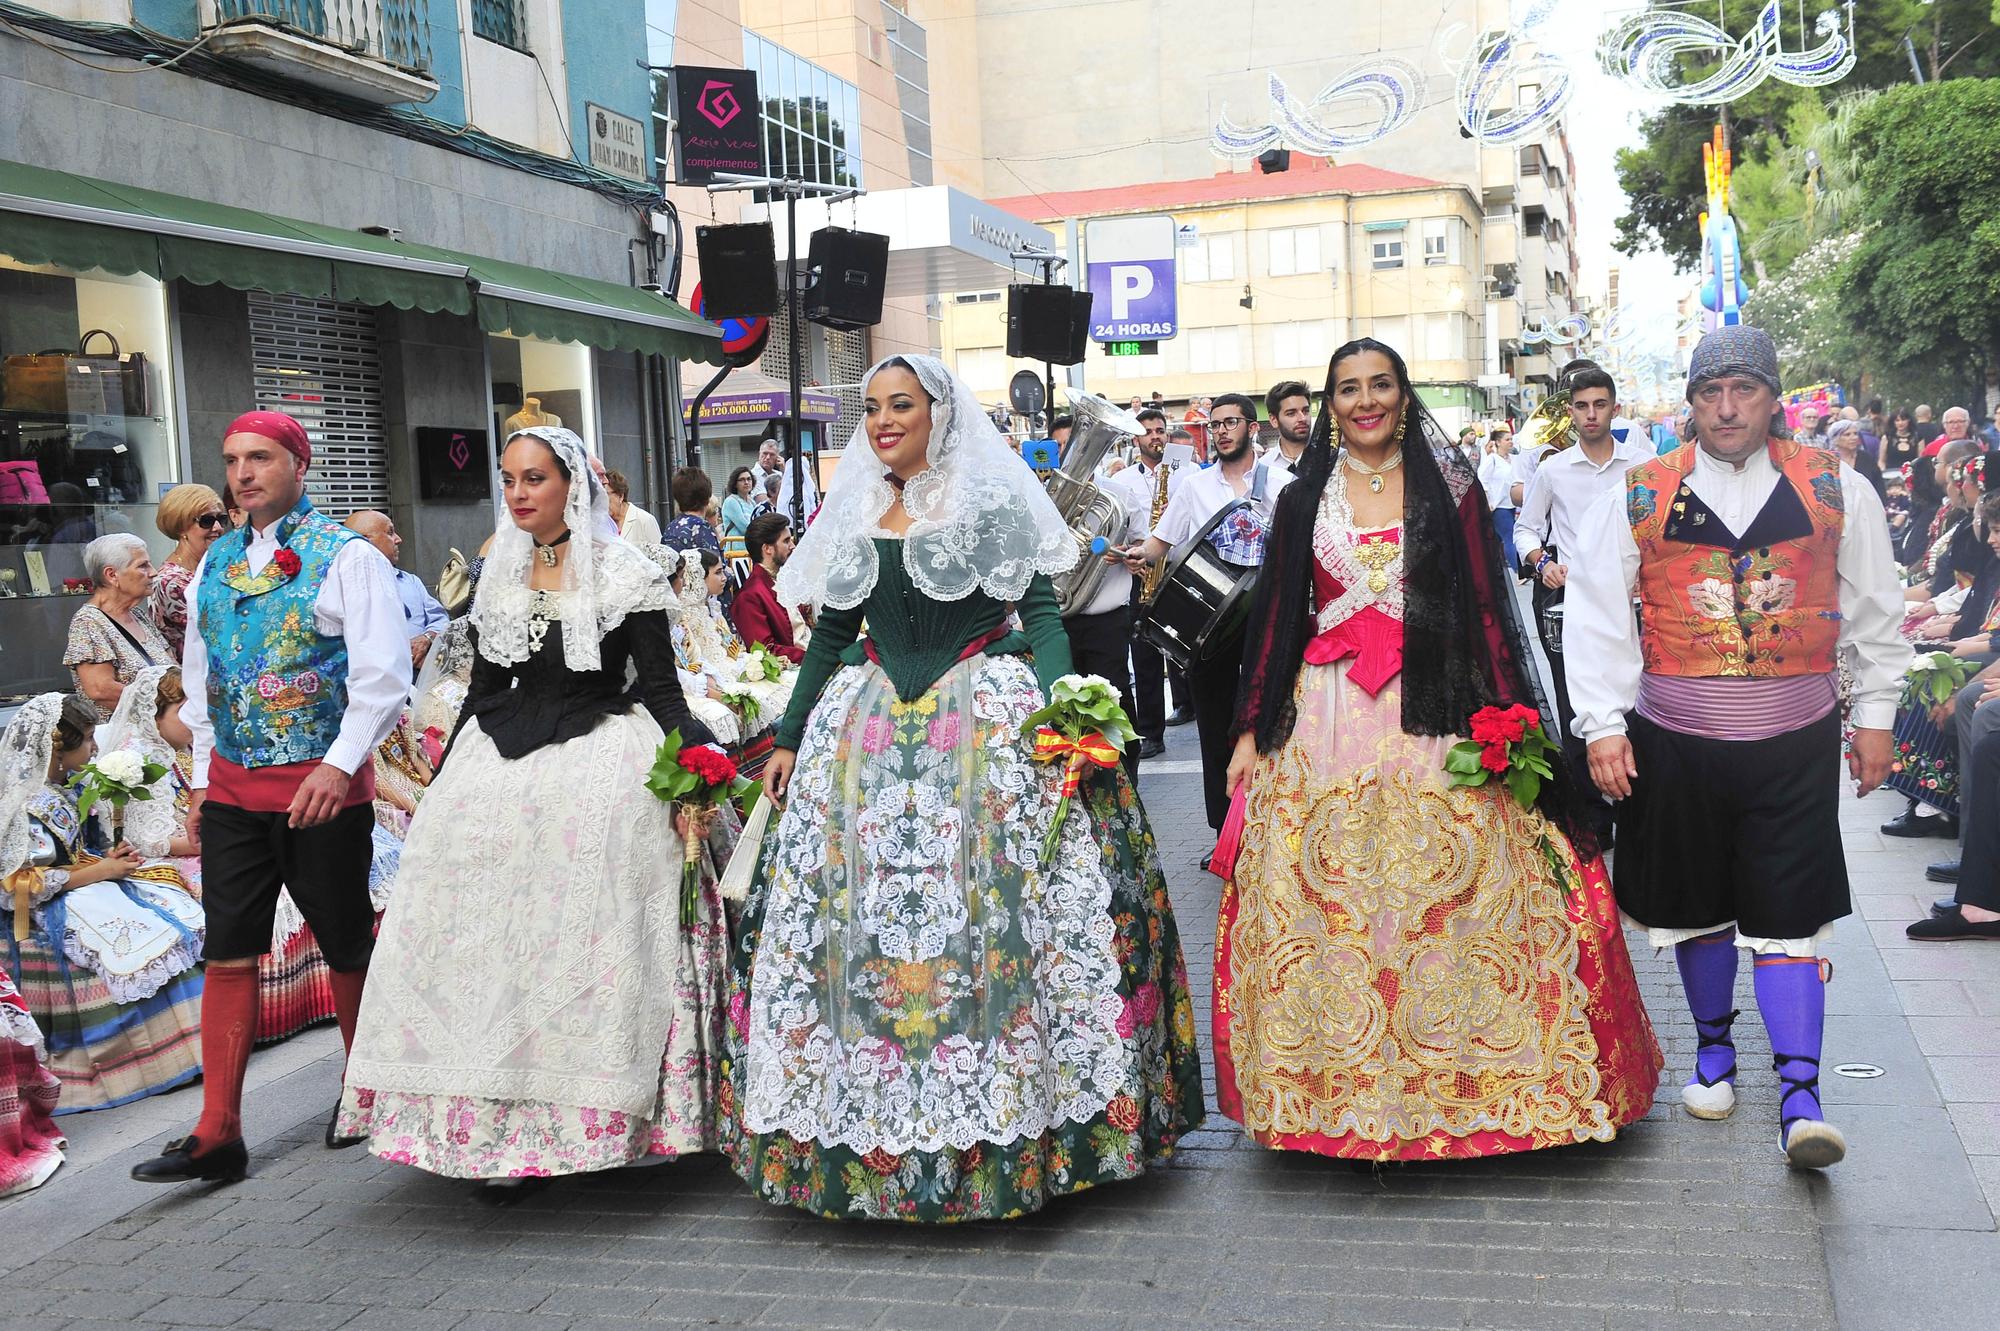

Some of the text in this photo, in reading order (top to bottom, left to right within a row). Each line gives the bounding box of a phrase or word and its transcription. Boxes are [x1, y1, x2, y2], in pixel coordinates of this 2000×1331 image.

[612, 119, 634, 146] CALLE
[594, 142, 611, 166] JUAN
[613, 149, 639, 175] CARLOS
[686, 157, 759, 169] complementos
[1110, 265, 1154, 320] P
[1096, 322, 1172, 337] 24 HORAS
